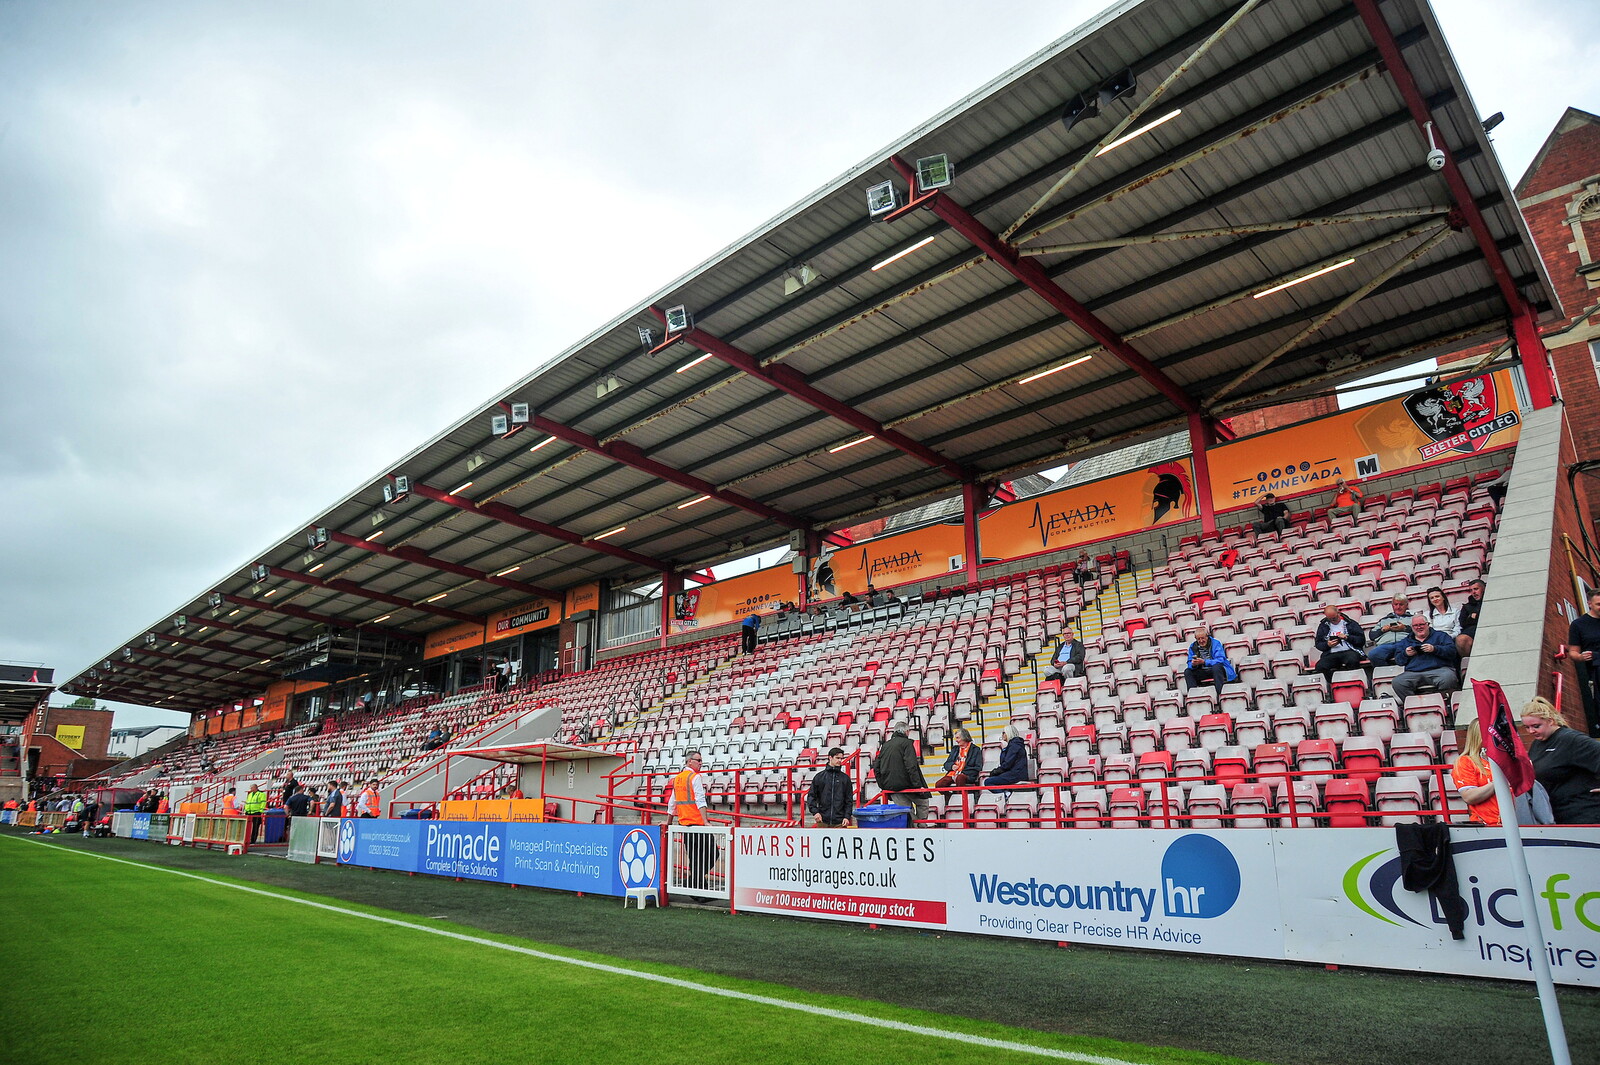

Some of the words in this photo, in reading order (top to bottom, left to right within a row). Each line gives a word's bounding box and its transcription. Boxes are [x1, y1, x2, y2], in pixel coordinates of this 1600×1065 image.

[1422, 433, 1468, 457] EXETER
[1468, 422, 1495, 439] CITY
[1496, 415, 1514, 429] FC
[1357, 457, 1378, 476] M
[1232, 466, 1342, 500] #TEAMNEVADA
[1028, 501, 1116, 548] NEVADA
[1050, 518, 1116, 537] CONSTRUCTION
[858, 547, 922, 585] NEVADA
[873, 564, 922, 578] CONSTRUCTION
[951, 558, 960, 570] L
[497, 620, 509, 631] OUR
[511, 608, 548, 627] COMMUNITY
[655, 627, 661, 636] K
[426, 823, 500, 863] Pinnacle
[510, 839, 544, 855] Managed
[545, 840, 564, 852] Print
[565, 841, 608, 857] Specialists
[740, 835, 811, 858] MARSH
[822, 836, 935, 863] GARAGES
[425, 858, 451, 873] Complete
[451, 860, 470, 875] Office
[470, 862, 498, 878] Solutions
[514, 856, 533, 870] Print,
[534, 859, 552, 871] Scan
[553, 859, 560, 872] &
[561, 860, 600, 878] Archiving
[769, 863, 897, 889] marshgarages.co.uk
[755, 891, 774, 905] Over
[775, 893, 790, 906] 100
[791, 894, 810, 909] used
[812, 896, 847, 912] vehicles
[847, 899, 857, 912] in
[858, 902, 887, 918] group
[888, 902, 916, 918] stock
[969, 873, 1157, 922] Westcountry
[1165, 877, 1205, 914] hr
[979, 914, 1033, 934] Providing
[1036, 918, 1070, 934] Clear
[1073, 921, 1122, 938] Precise
[1126, 925, 1149, 940] HR
[1152, 927, 1202, 944] Advice
